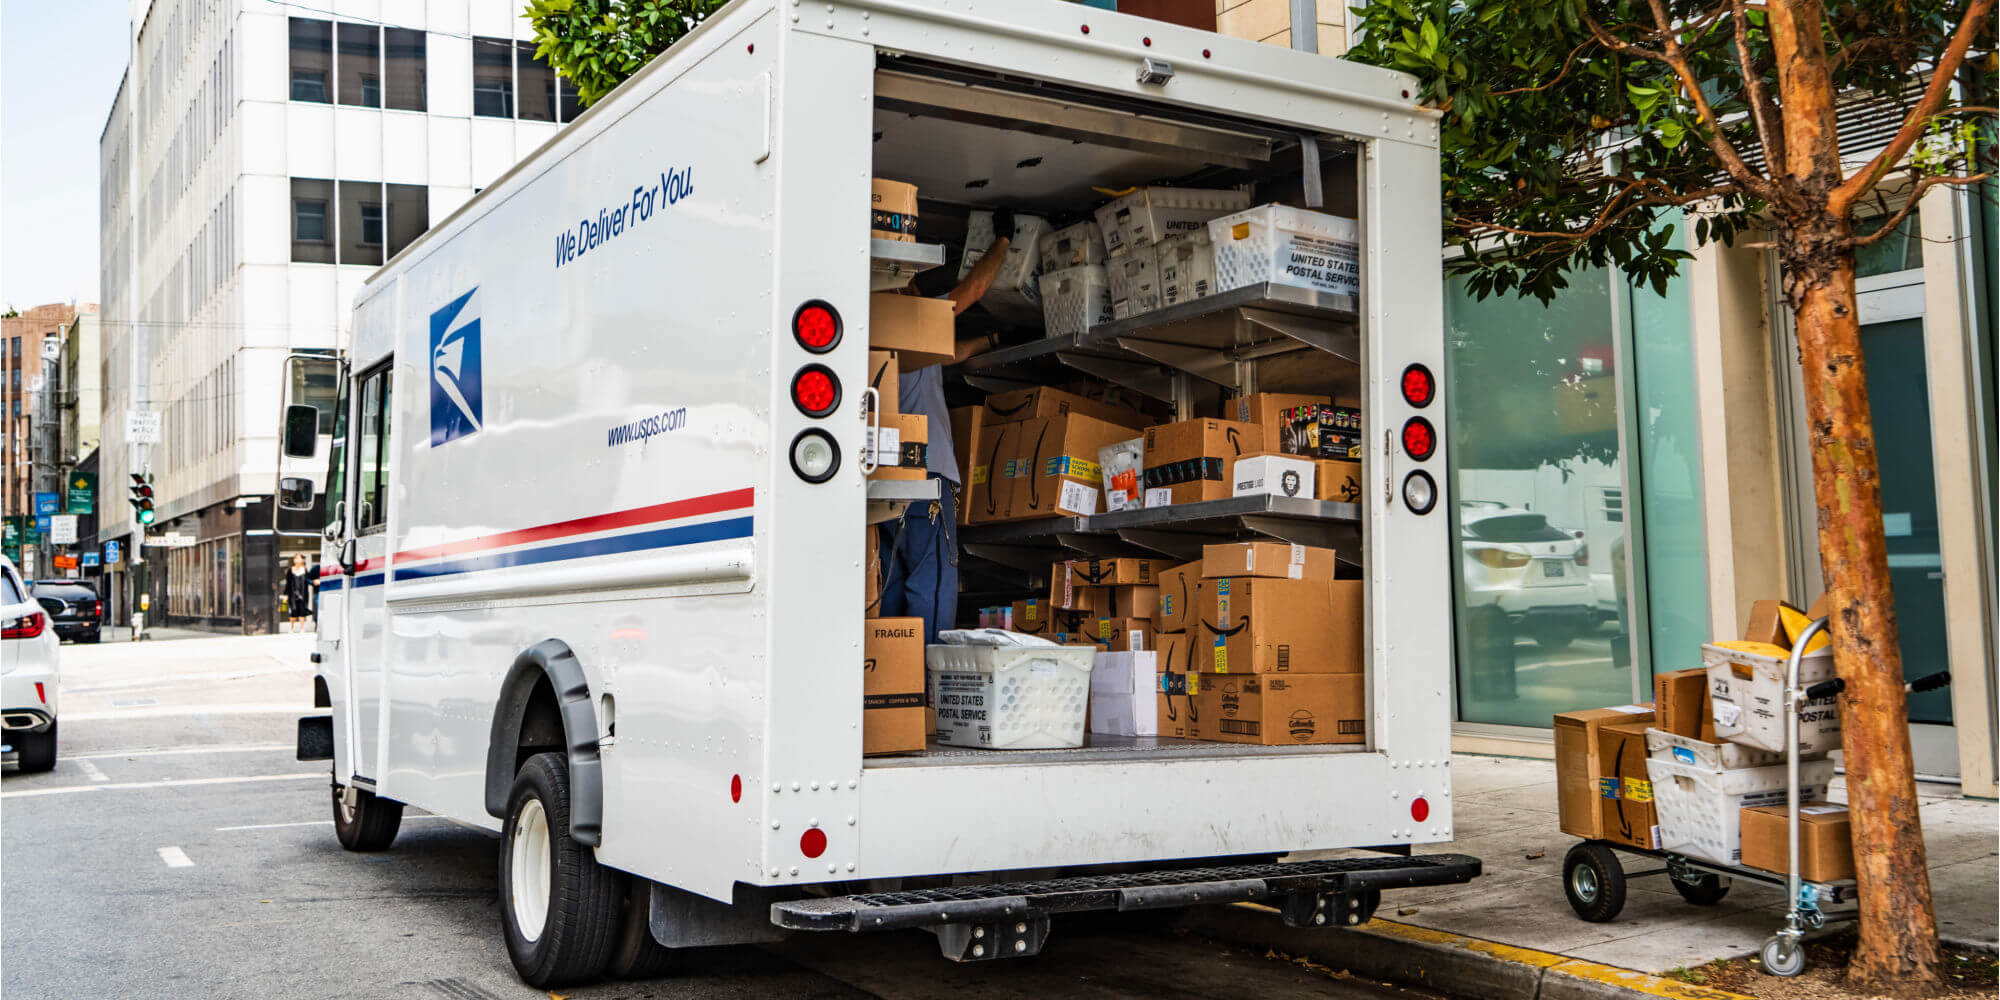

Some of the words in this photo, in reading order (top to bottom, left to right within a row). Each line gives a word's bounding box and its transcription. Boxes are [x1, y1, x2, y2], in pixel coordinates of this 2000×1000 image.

[556, 229, 576, 269] We
[577, 202, 630, 257] Deliver
[630, 185, 659, 228] For
[661, 166, 694, 210] You.
[1166, 220, 1200, 231] UNITED
[1291, 252, 1325, 267] UNITED
[1286, 265, 1323, 280] POSTAL
[1324, 272, 1359, 287] SERVIC
[608, 407, 686, 448] www.usps.com
[875, 628, 915, 639] FRAGILE
[940, 695, 959, 705] UNITED
[960, 696, 984, 706] STATES
[939, 707, 960, 719] POSTAL
[961, 709, 987, 721] SERVICE
[1798, 710, 1837, 722] POSTAL
